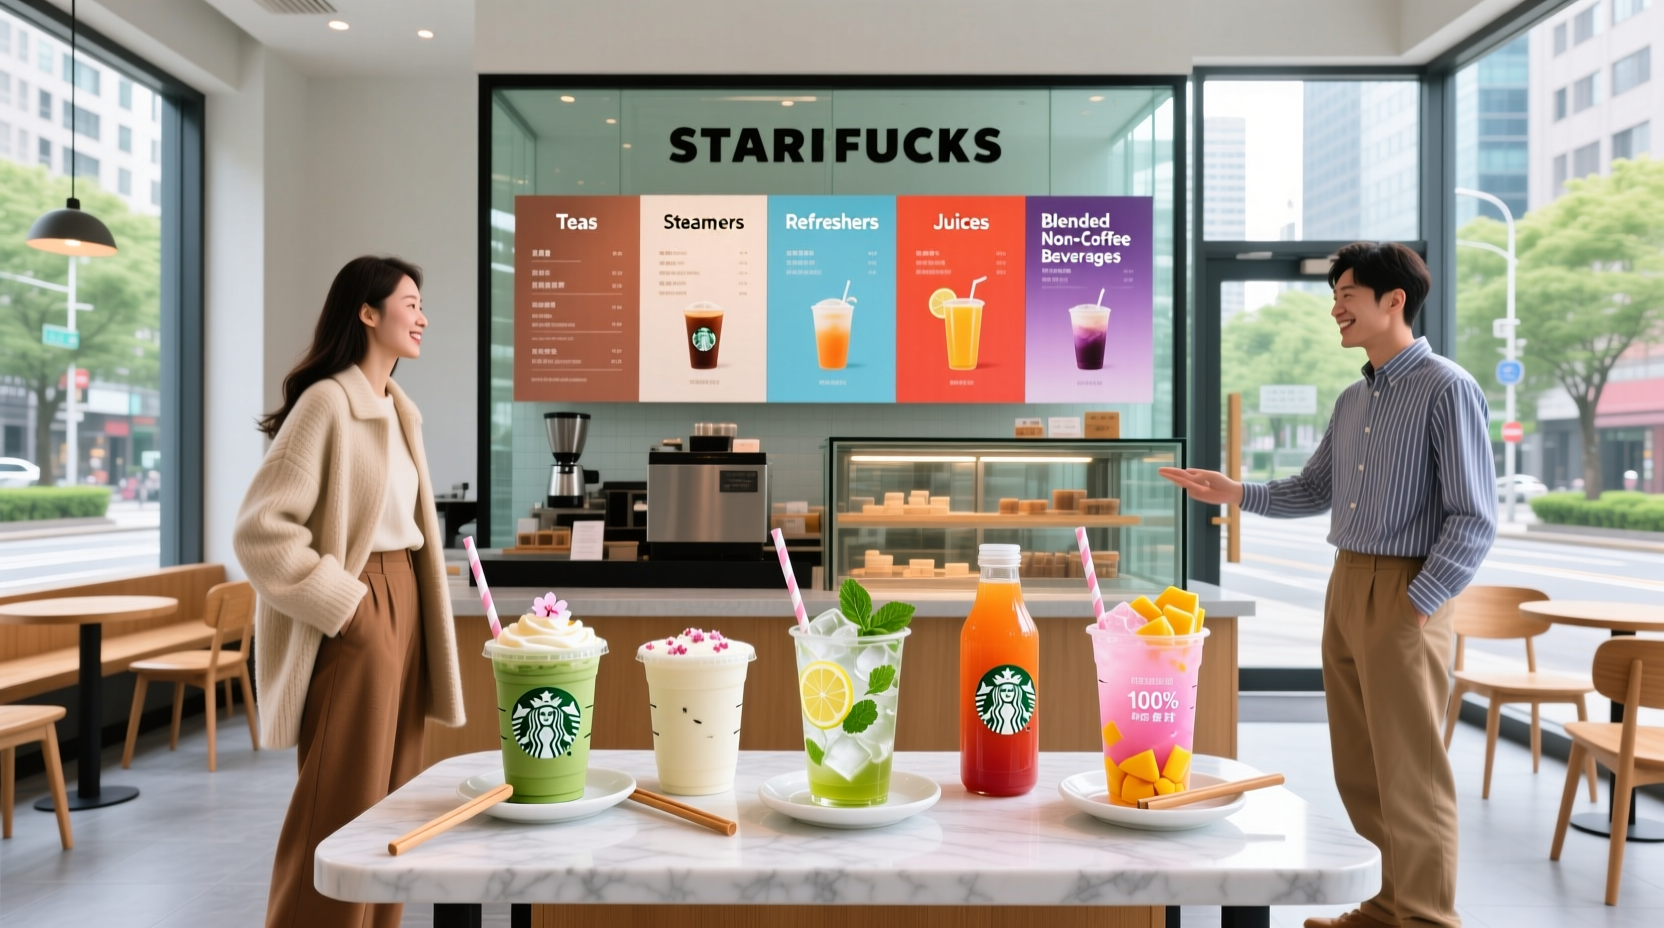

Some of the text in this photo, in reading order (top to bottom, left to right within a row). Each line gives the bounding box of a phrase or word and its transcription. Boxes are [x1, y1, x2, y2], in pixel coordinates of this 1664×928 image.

[556, 213, 598, 230] Teas
[663, 213, 745, 230] Steamers
[785, 212, 879, 230] Refreshers
[933, 212, 990, 230] Juices
[1041, 212, 1110, 229] Blended
[1041, 231, 1132, 247] Non-Coffee
[1041, 248, 1121, 267] Beverages
[1127, 691, 1179, 710] 100%
